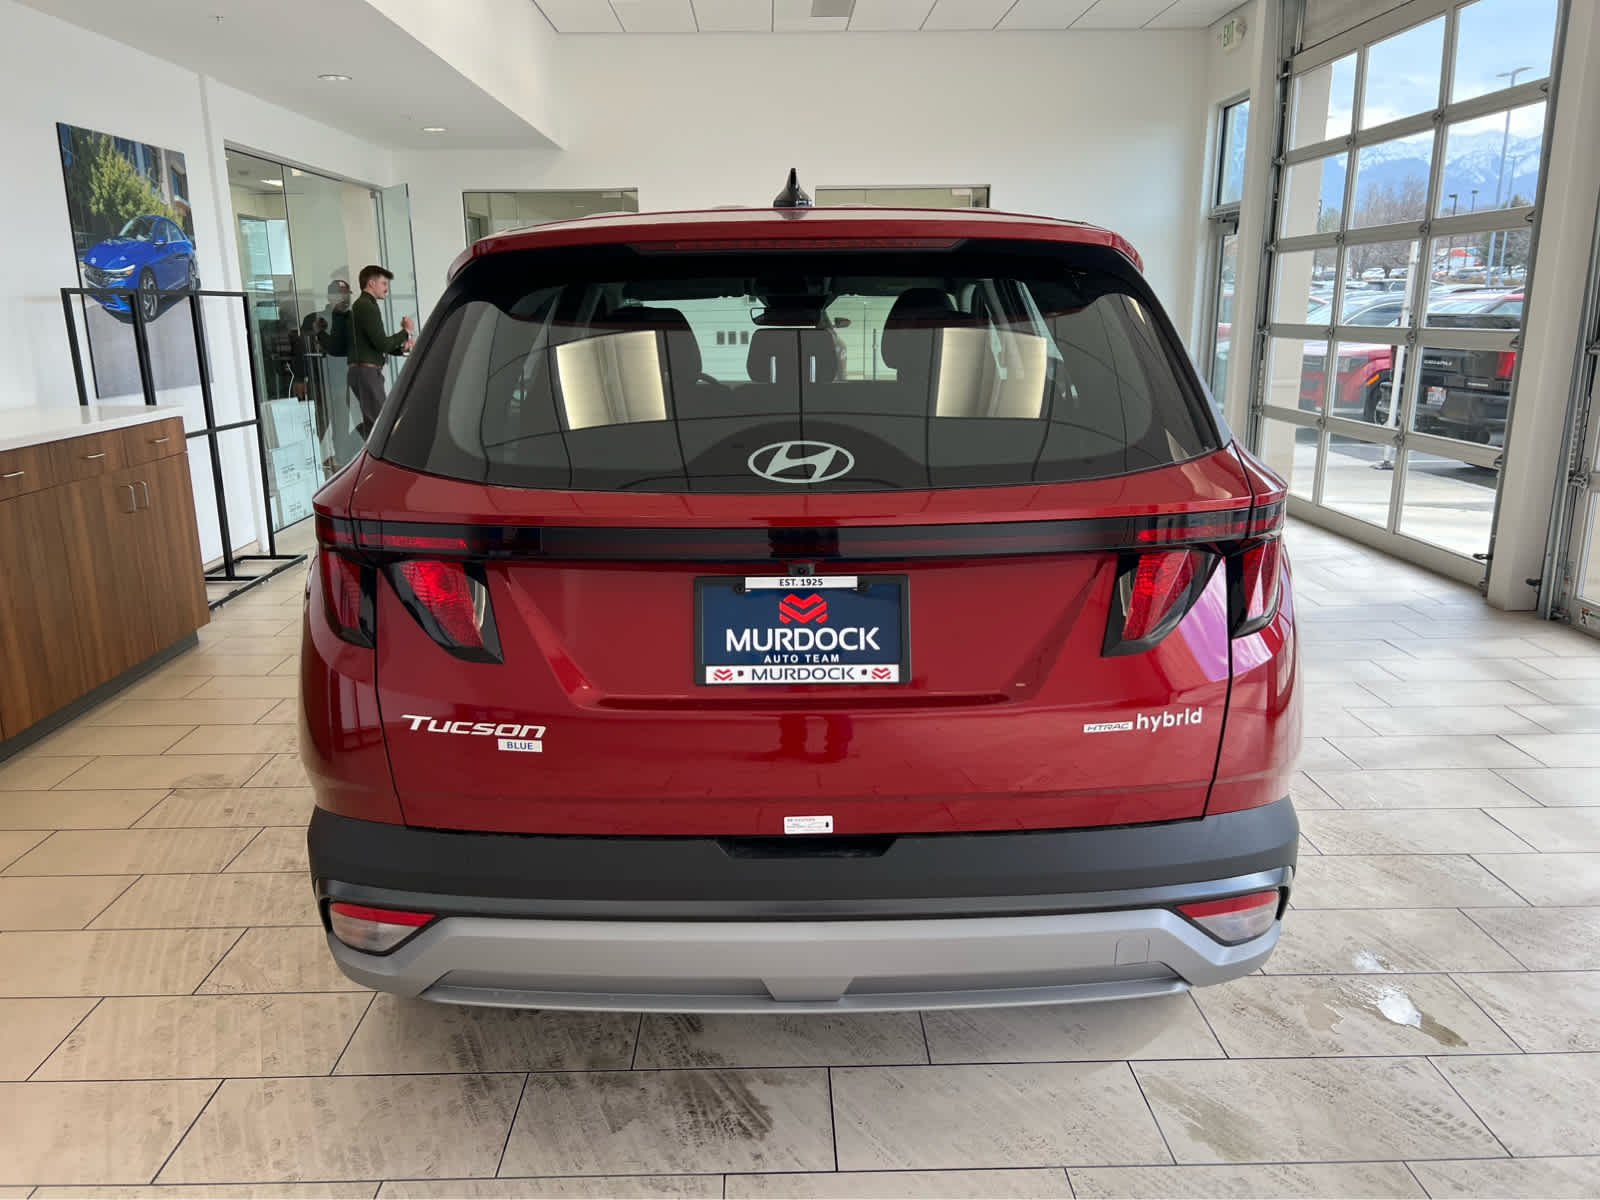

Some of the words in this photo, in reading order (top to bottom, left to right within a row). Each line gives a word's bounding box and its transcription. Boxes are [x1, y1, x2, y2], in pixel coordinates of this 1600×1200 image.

[801, 578, 823, 586] 1925
[725, 627, 881, 652] MURDOCK
[764, 654, 799, 664] AUTO
[804, 654, 840, 663] TEAM
[751, 667, 855, 681] MURDOCK
[1086, 723, 1130, 731] HTRAC
[1136, 706, 1203, 733] hybrid
[506, 741, 534, 750] BLUE
